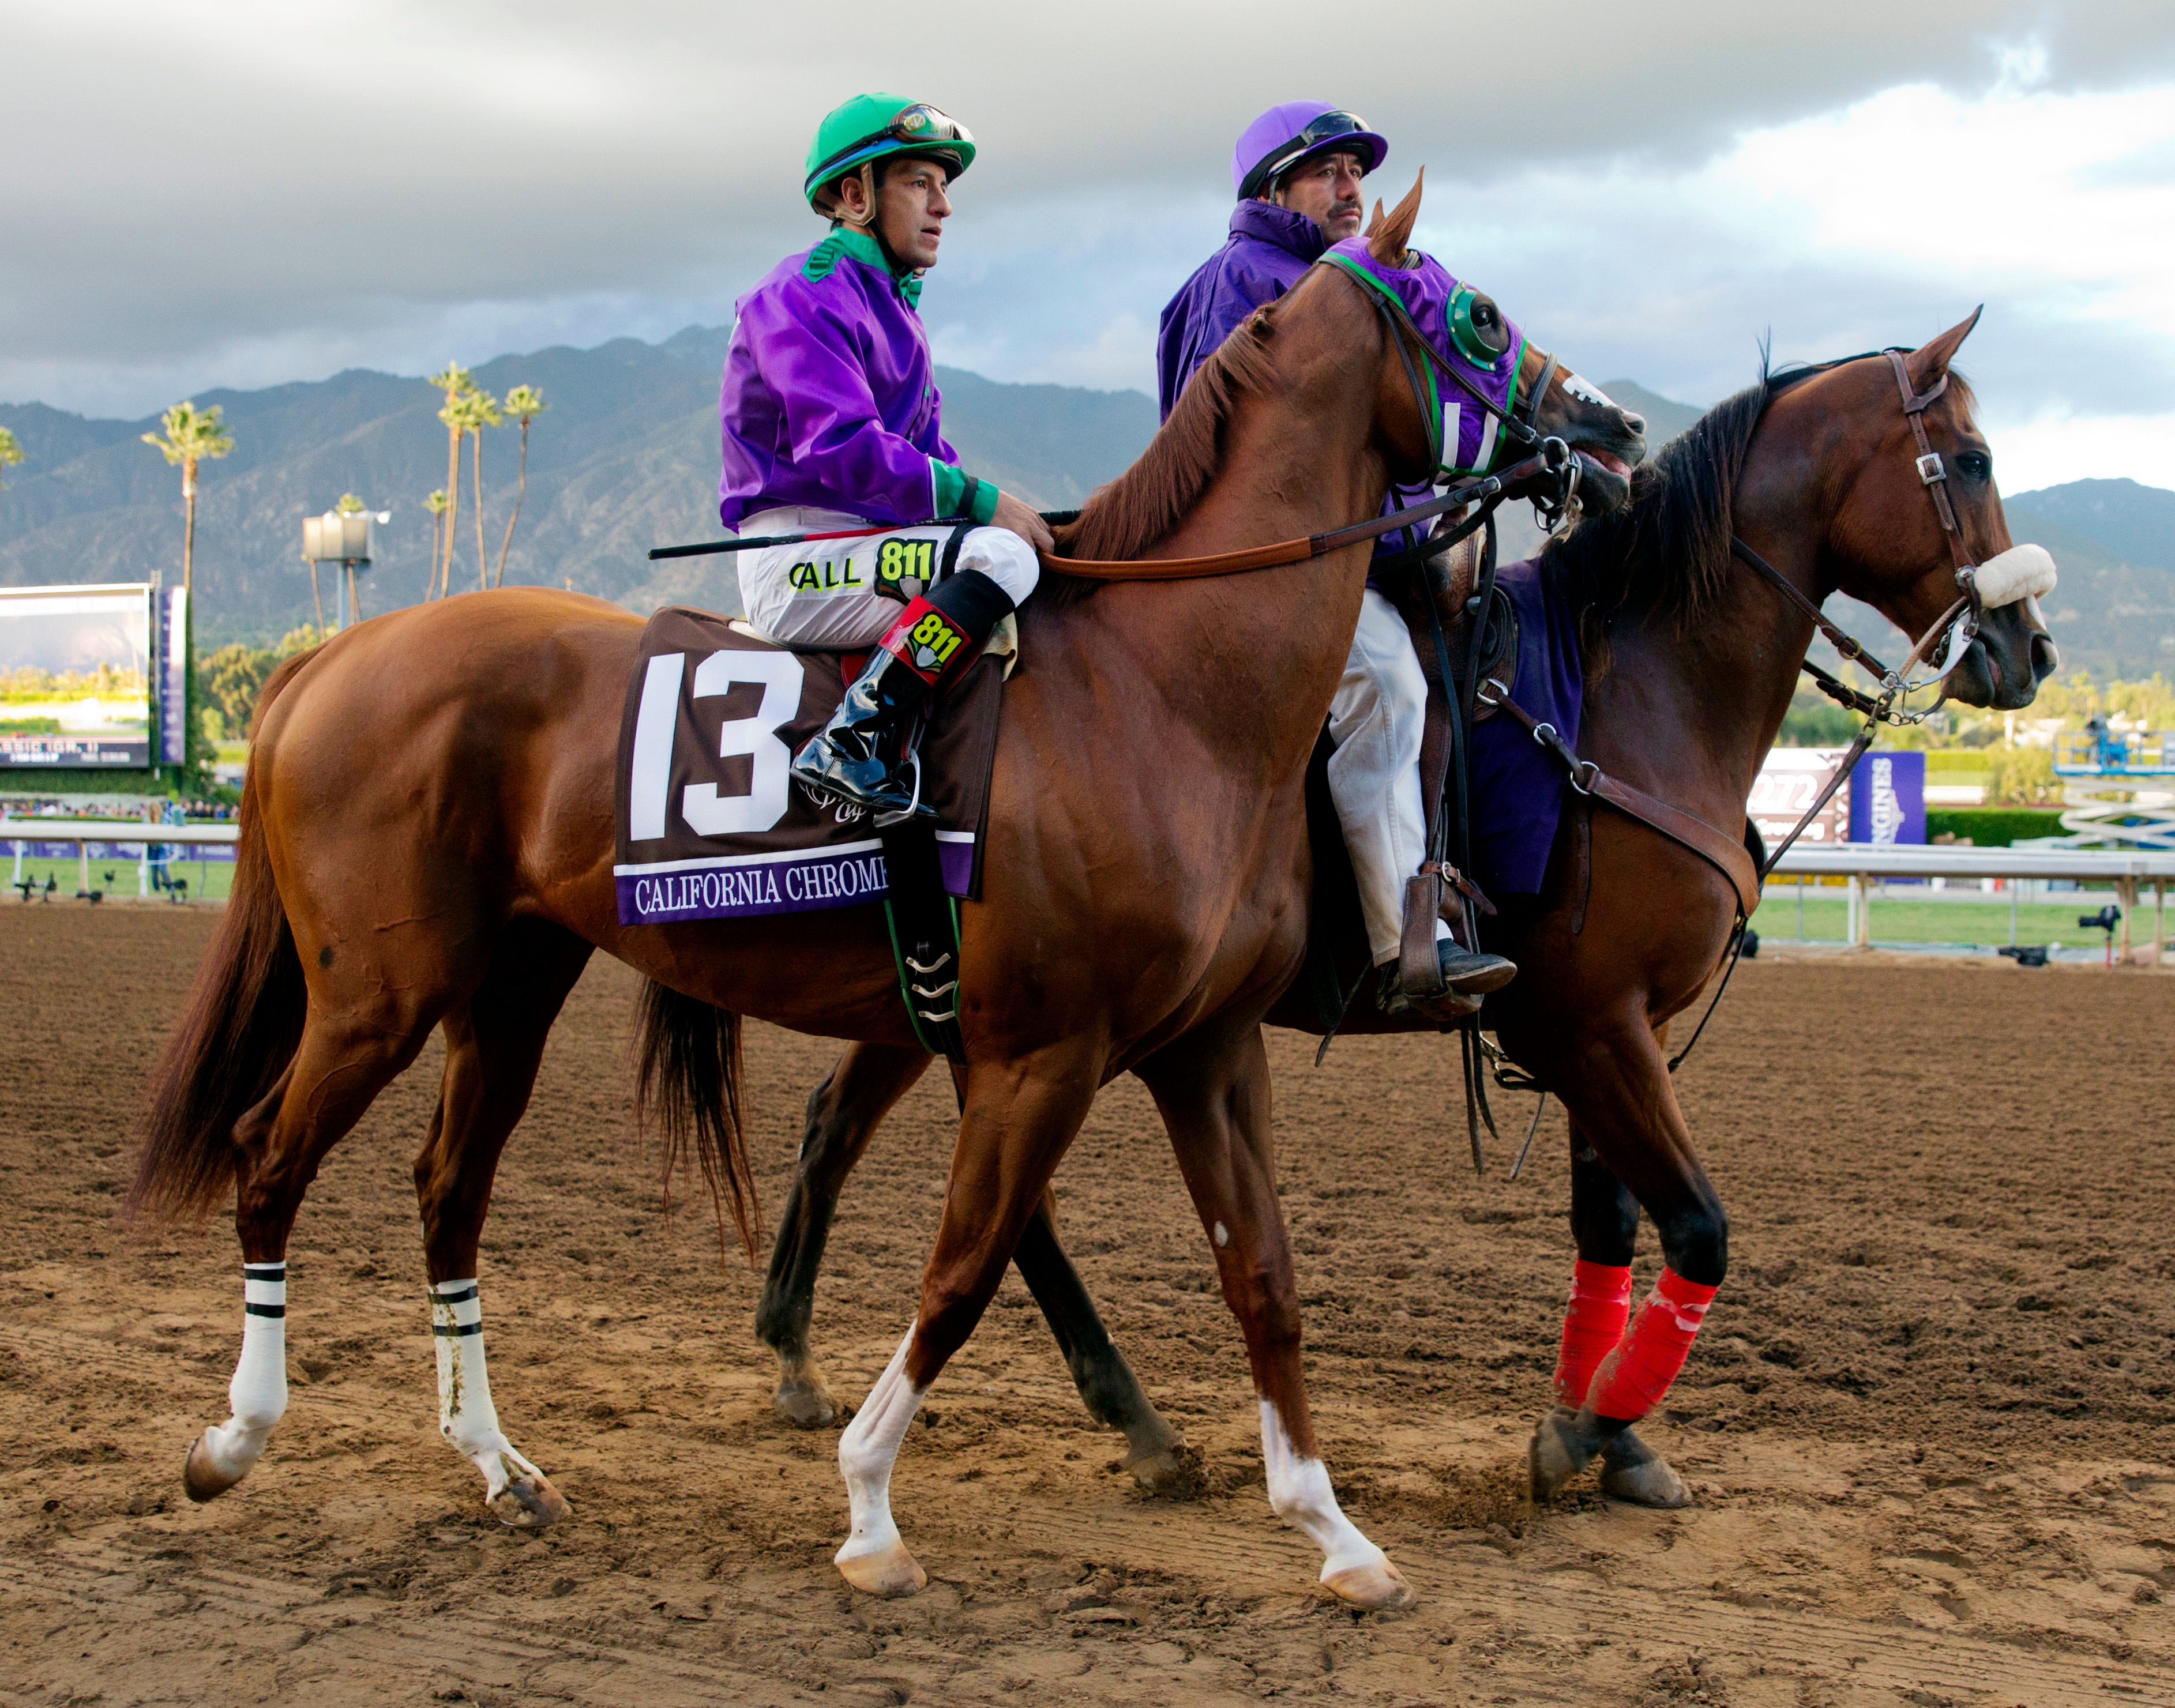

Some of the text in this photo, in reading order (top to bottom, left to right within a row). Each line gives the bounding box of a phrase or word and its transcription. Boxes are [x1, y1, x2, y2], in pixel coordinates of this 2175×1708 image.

[789, 541, 931, 592] CALL 811
[914, 614, 962, 663] 811
[630, 649, 805, 841] 13
[835, 800, 867, 823] Cup
[636, 869, 782, 915] CALIFORNIA
